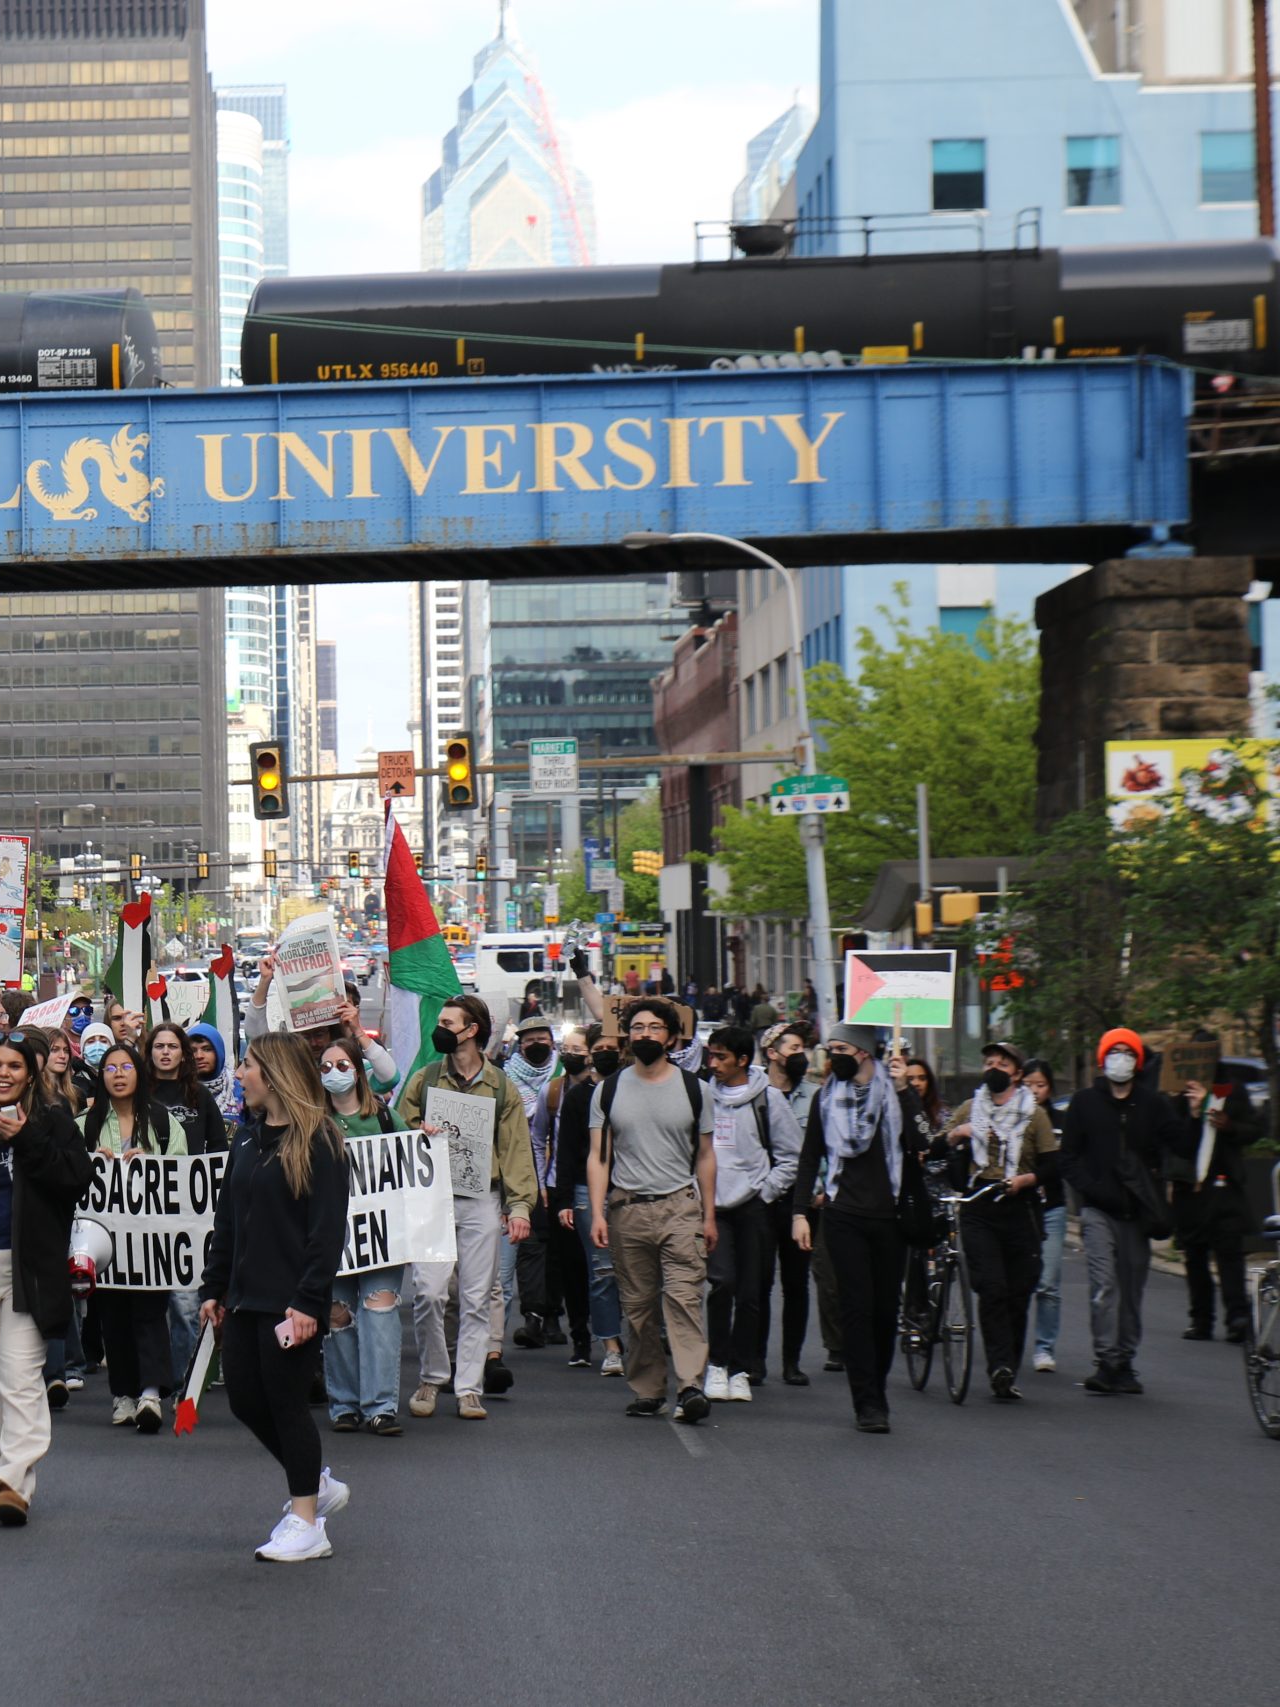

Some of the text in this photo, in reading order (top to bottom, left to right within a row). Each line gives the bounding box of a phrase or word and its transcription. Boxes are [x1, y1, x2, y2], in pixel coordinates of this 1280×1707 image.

[317, 362, 438, 380] UTLX 956440
[195, 412, 846, 502] UNIVERSITY
[383, 755, 410, 766] TRUCK
[380, 767, 413, 778] DETOUR
[278, 942, 329, 962] WORLDWIDE
[288, 938, 315, 950] FIGHT FOR
[280, 952, 333, 976] INTIFADA
